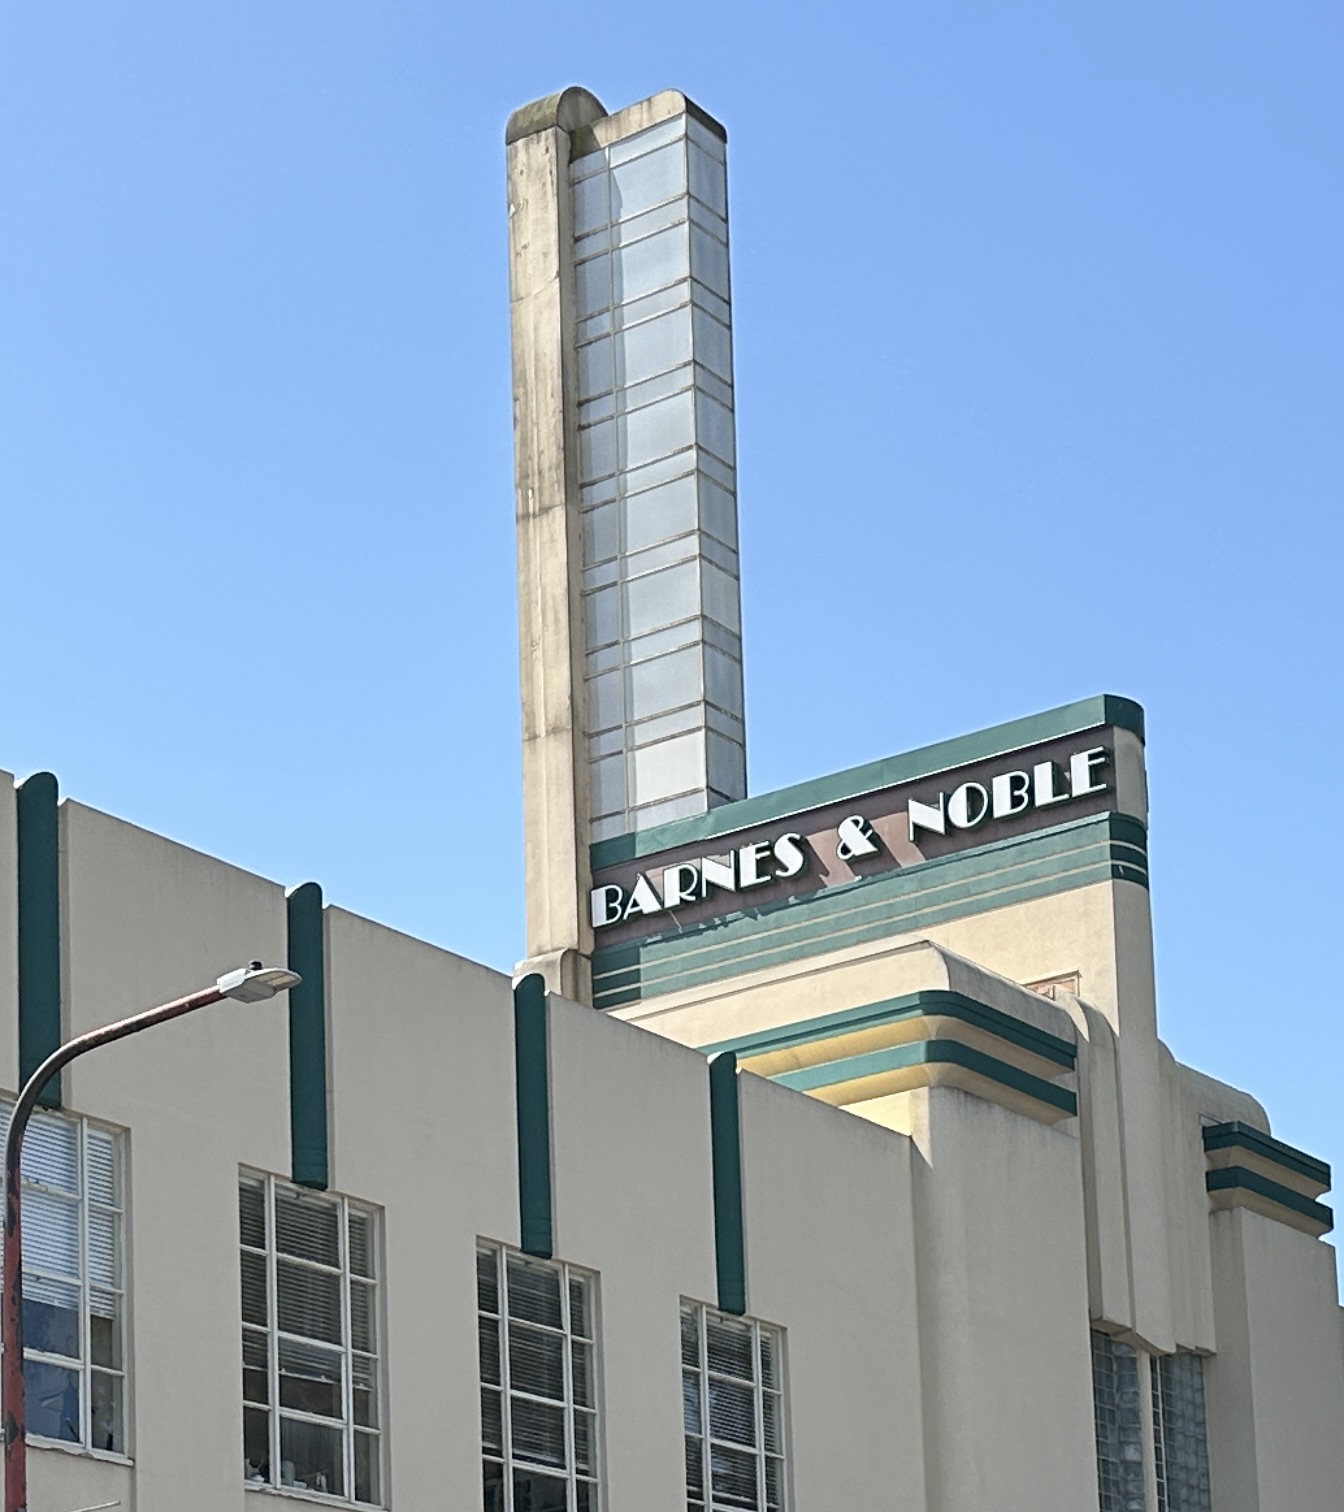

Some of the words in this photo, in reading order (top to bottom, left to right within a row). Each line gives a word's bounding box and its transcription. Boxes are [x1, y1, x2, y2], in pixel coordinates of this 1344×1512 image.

[592, 831, 805, 929] BARNES
[836, 814, 879, 860] &
[908, 746, 1110, 842] NOBLE
